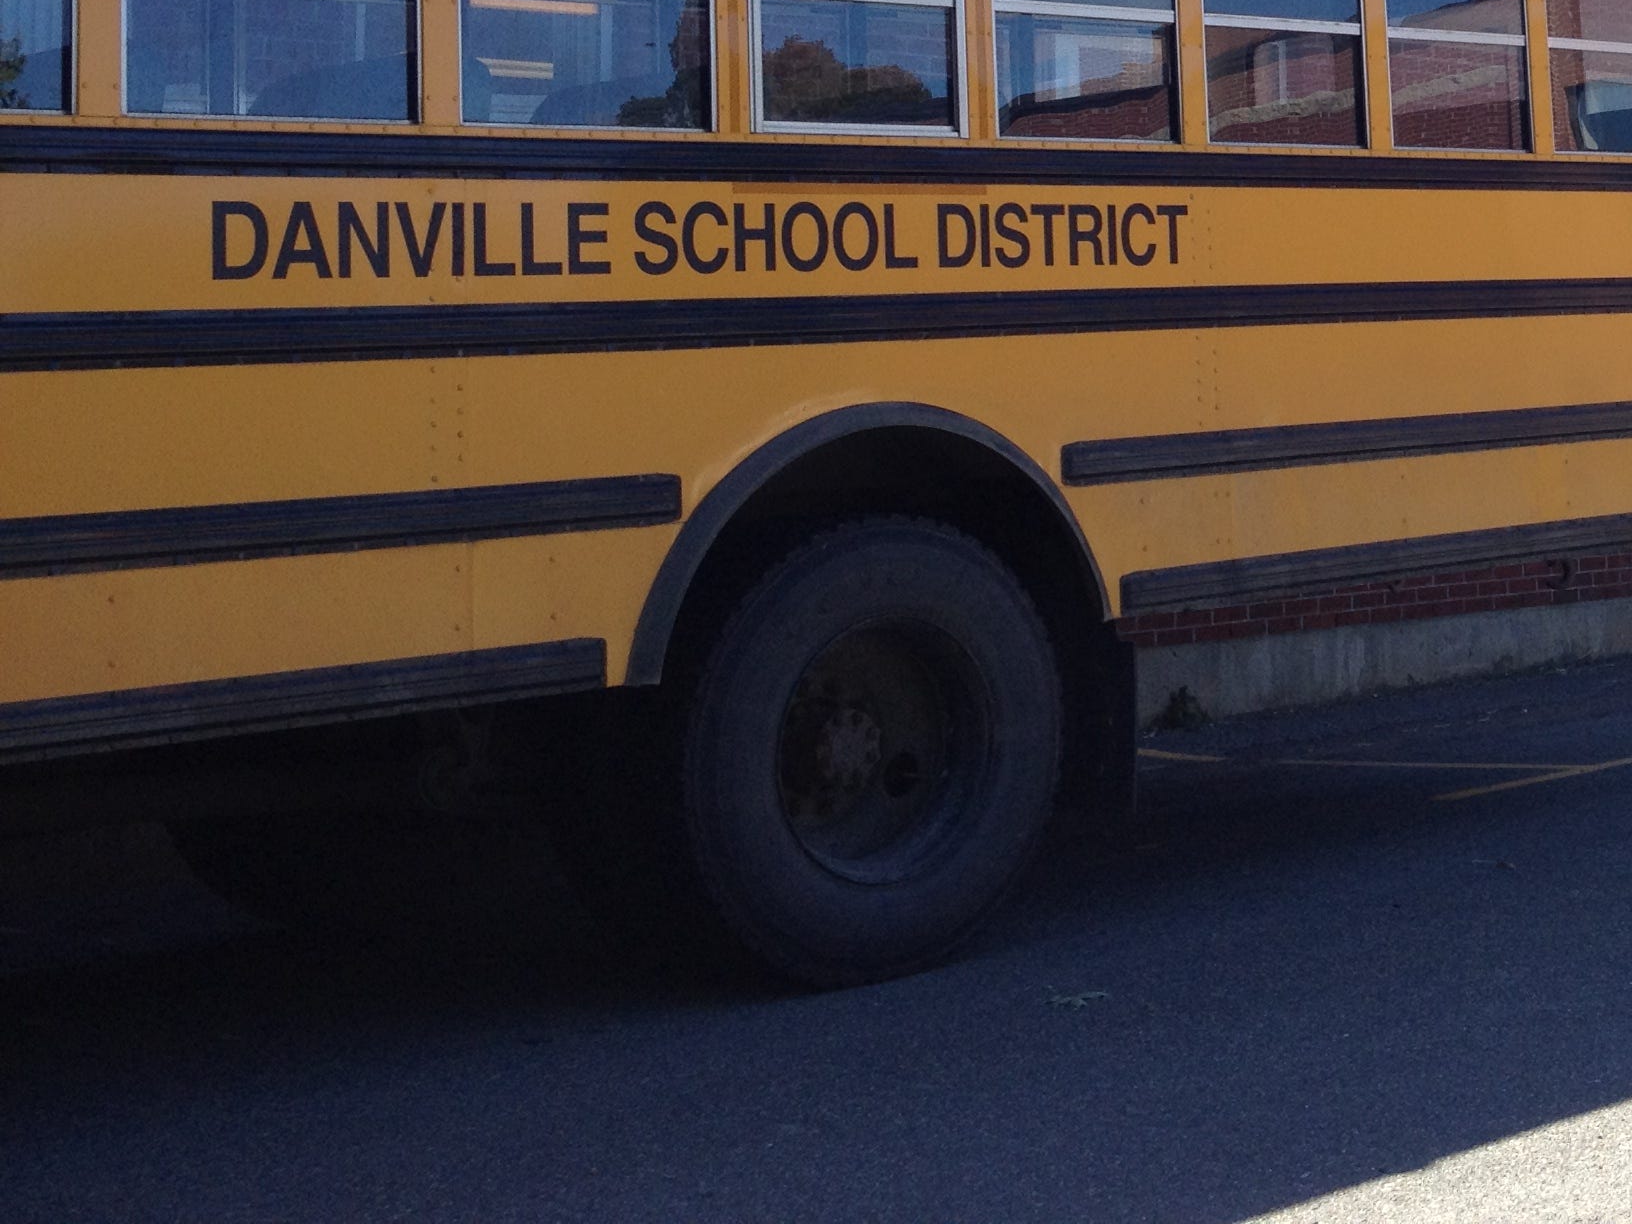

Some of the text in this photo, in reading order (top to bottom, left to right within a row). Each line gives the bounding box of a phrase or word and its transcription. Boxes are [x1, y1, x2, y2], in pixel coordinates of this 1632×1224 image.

[212, 201, 1189, 281] DANVILLE SCHOOL DISTRICT
